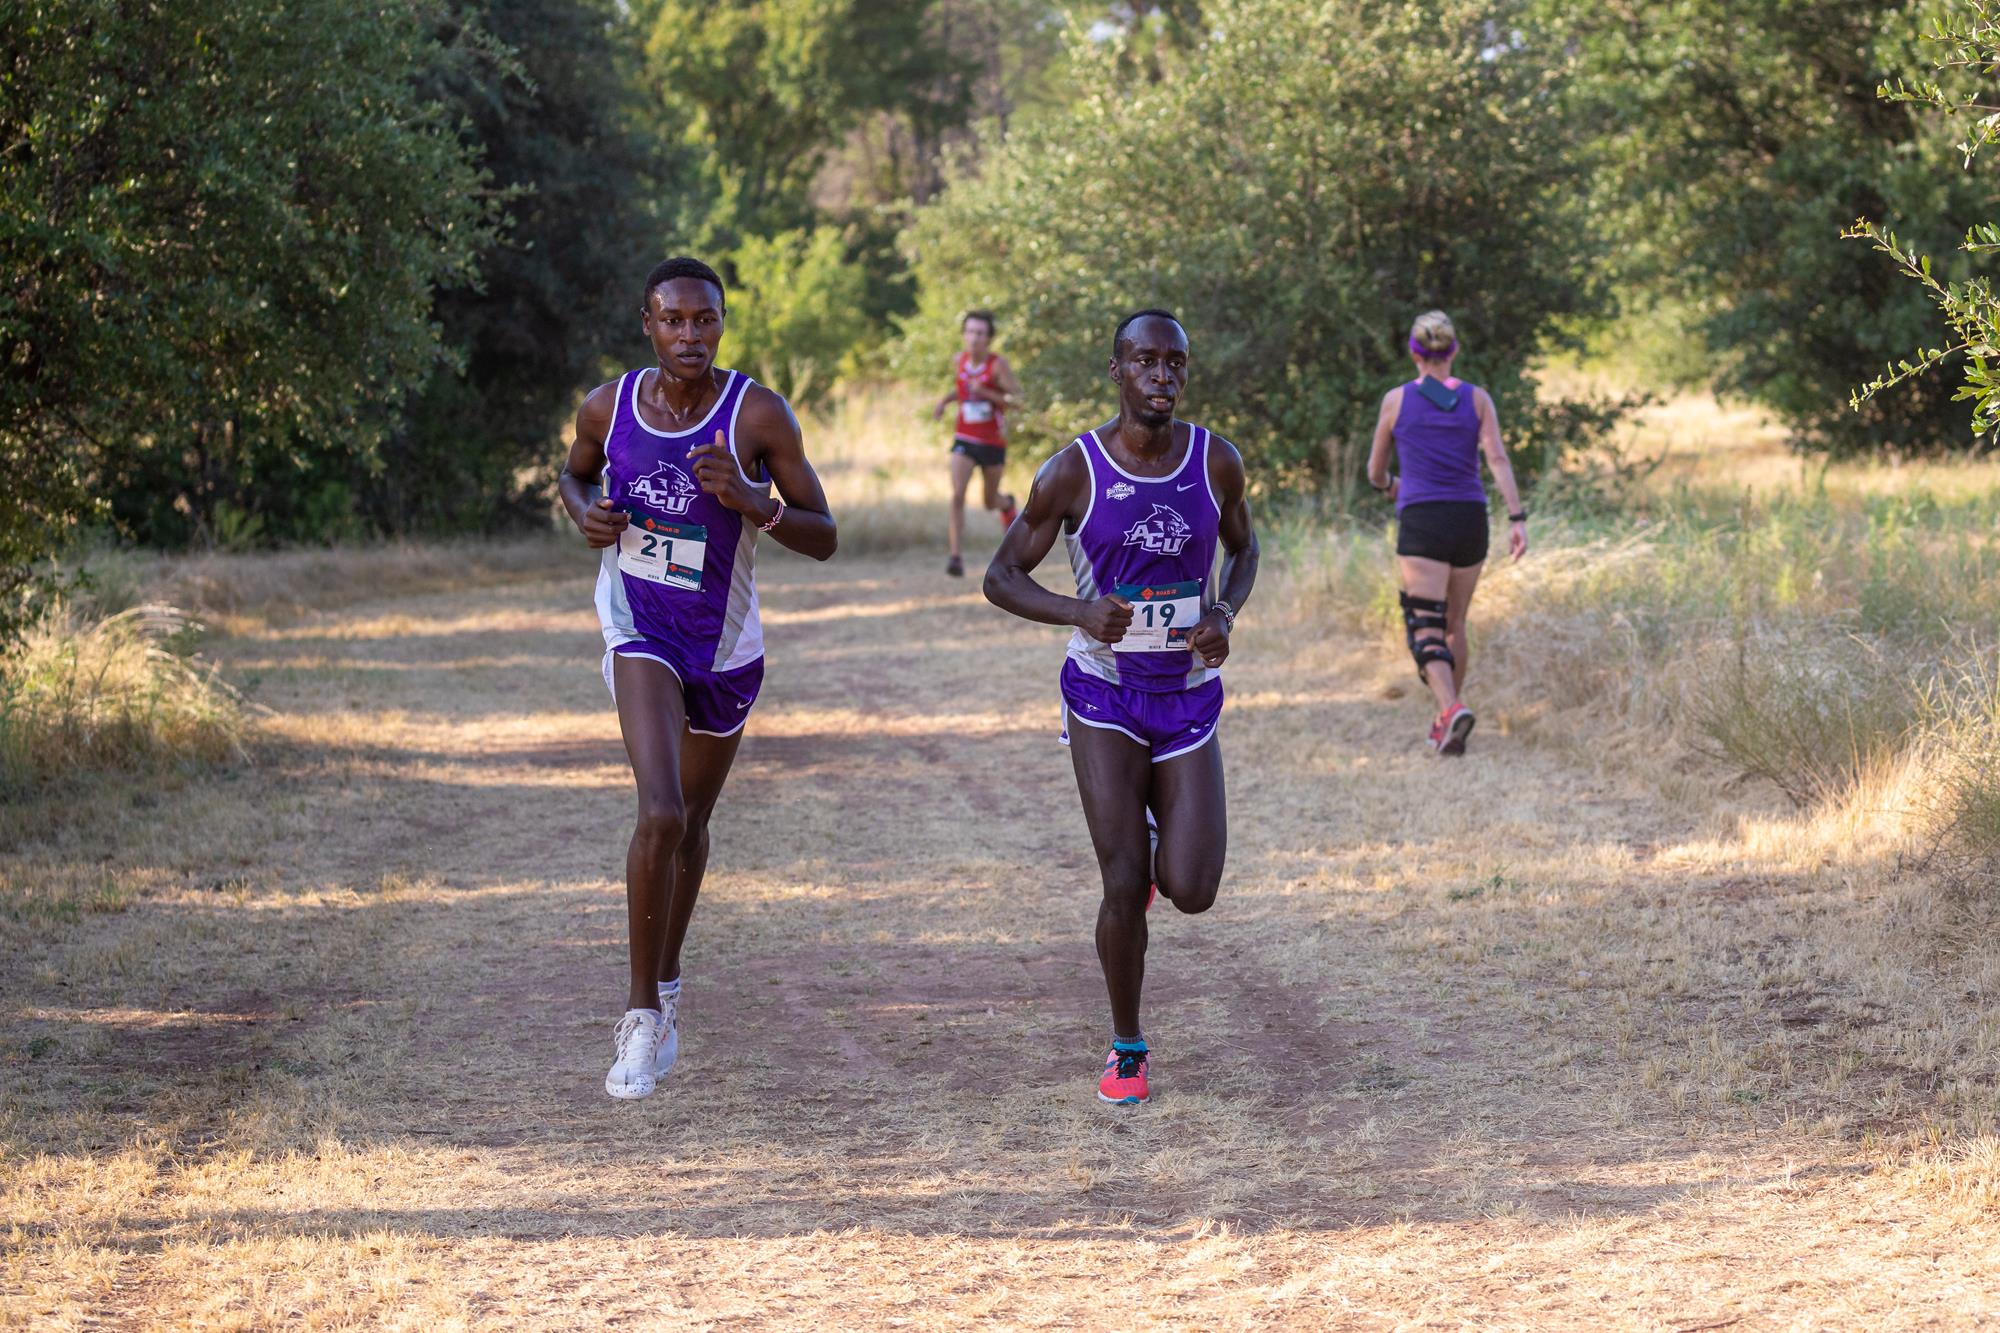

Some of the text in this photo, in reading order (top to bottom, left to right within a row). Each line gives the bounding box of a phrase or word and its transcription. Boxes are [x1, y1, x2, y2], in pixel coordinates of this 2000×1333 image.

[634, 479, 688, 512] ACU
[641, 534, 674, 561] 21
[1130, 524, 1183, 552] ACU
[1142, 603, 1176, 627] 19
